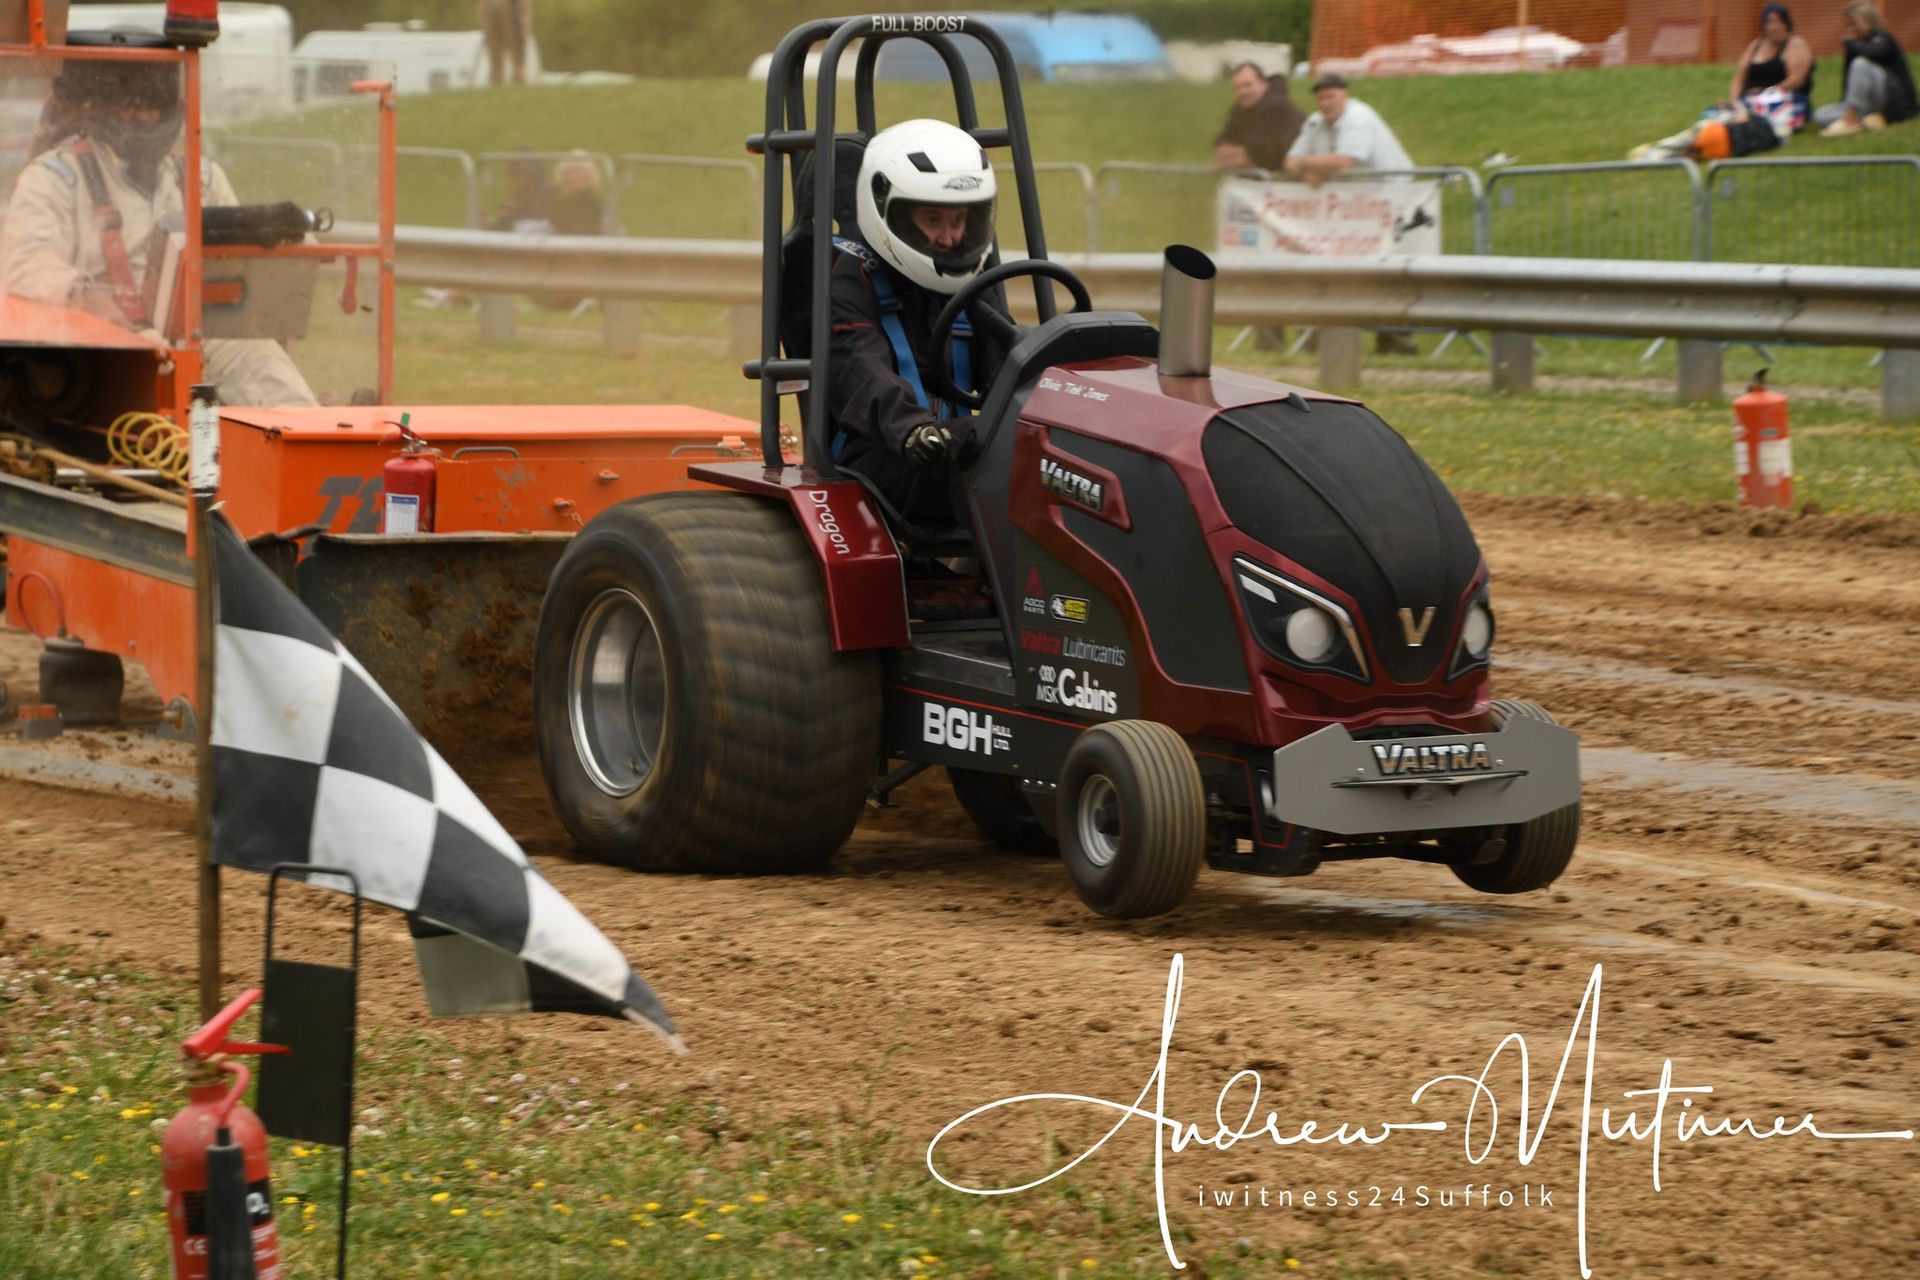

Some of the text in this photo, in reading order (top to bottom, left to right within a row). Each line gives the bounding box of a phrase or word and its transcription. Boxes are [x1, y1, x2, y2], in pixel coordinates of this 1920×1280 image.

[871, 15, 967, 33] FULL BOOST
[1326, 192, 1392, 228] Pulling
[1039, 457, 1103, 510] VALTRA
[808, 489, 851, 555] Dragon
[1020, 629, 1127, 668] Valtra Lubricants
[1057, 667, 1119, 715] Cabins
[922, 701, 993, 756] BGH
[1372, 742, 1491, 776] VALTRA
